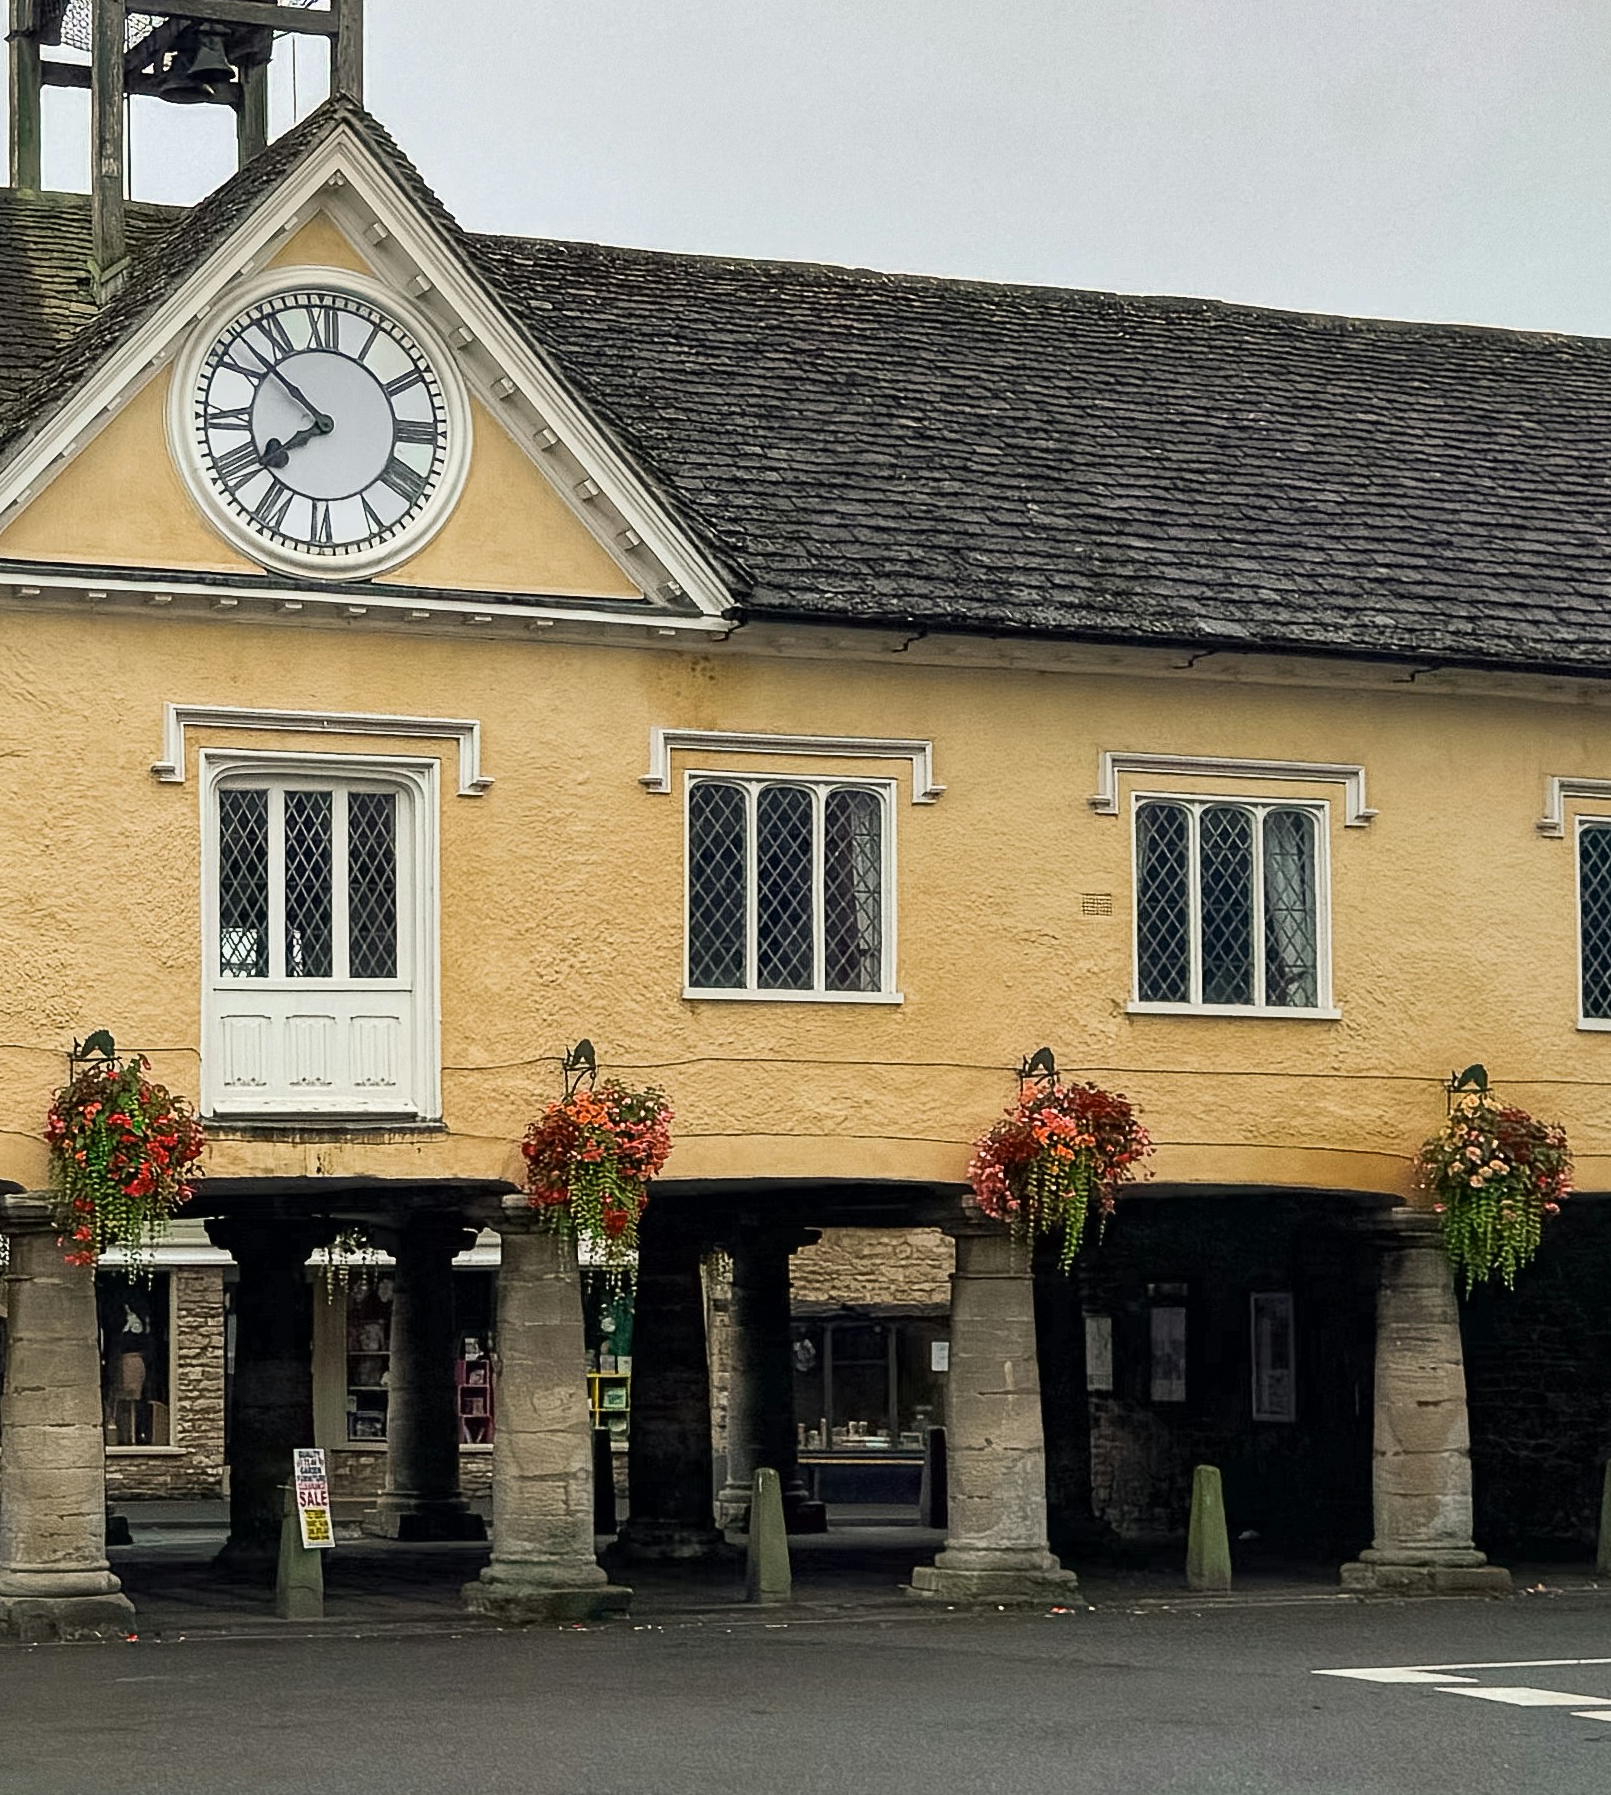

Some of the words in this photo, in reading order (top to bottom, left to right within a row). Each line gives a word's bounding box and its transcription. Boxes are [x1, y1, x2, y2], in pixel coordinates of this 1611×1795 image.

[251, 313, 294, 365] XI
[306, 306, 339, 352] XII
[218, 349, 264, 387] X
[381, 366, 426, 399] II
[207, 404, 252, 432] IX
[393, 419, 436, 445] III
[211, 441, 267, 495] VIII
[249, 478, 295, 532] VII
[309, 498, 333, 545] VI
[358, 492, 390, 535] V
[299, 1490, 328, 1507] SALE
